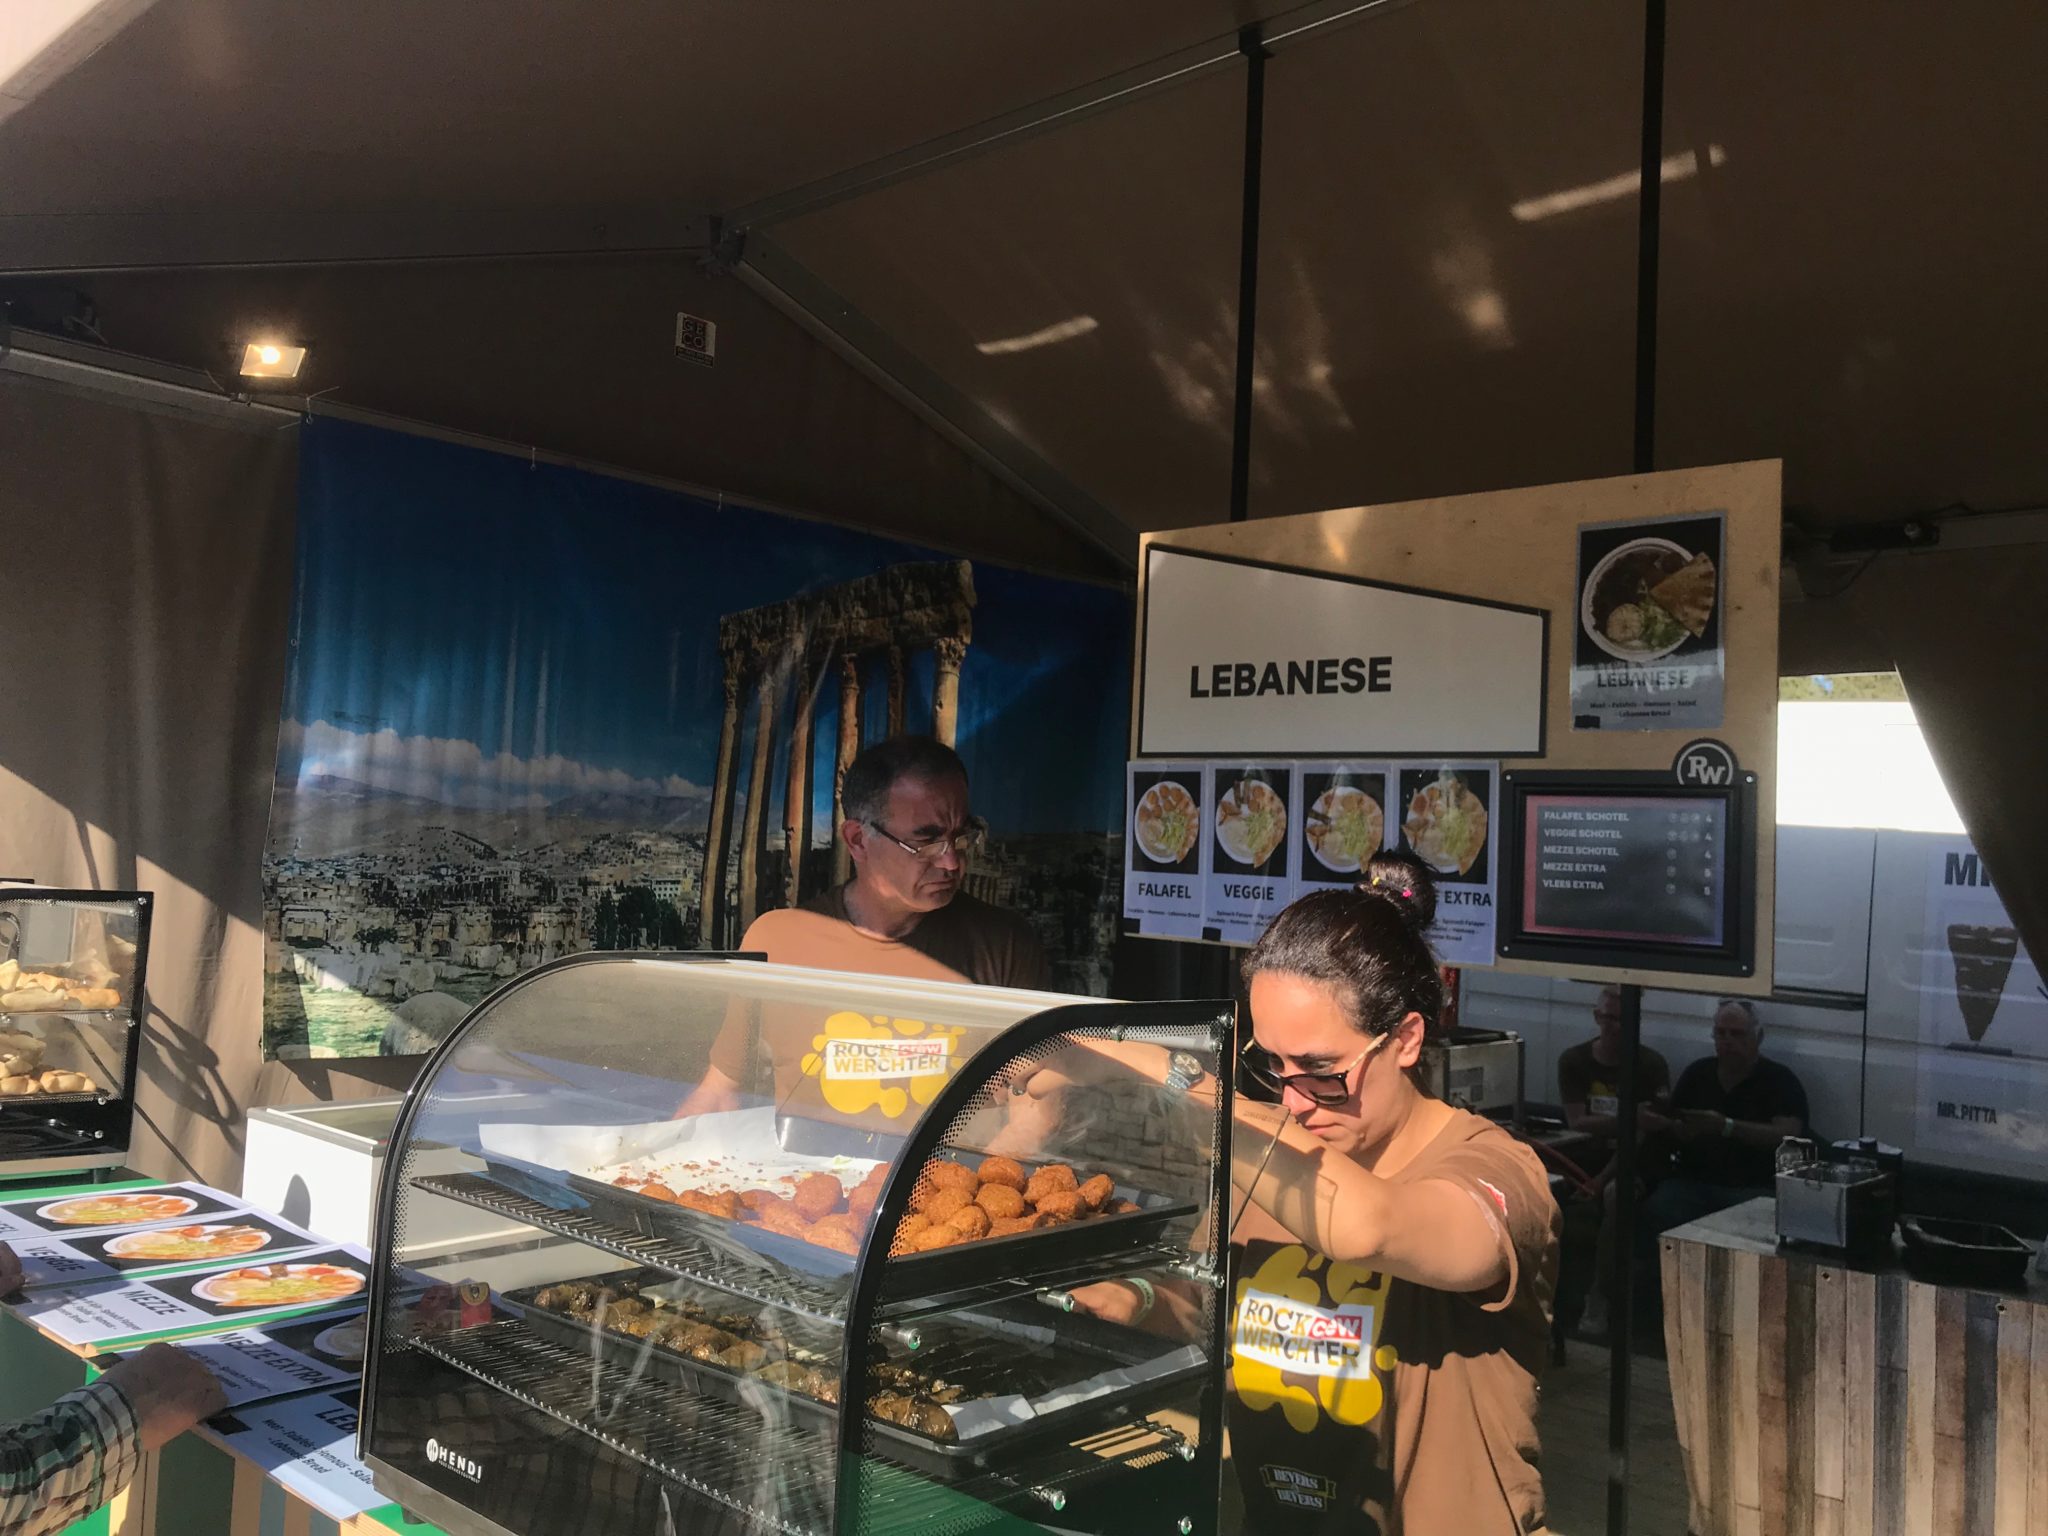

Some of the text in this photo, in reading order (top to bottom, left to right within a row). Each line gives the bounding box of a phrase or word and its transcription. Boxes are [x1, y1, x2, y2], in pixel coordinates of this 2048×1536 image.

[1190, 656, 1393, 698] LEBANESE
[1597, 668, 1690, 688] LEBANESE
[1687, 756, 1726, 785] RW
[1544, 811, 1584, 821] FALAFEL
[1586, 812, 1630, 822] SCHOTEL
[1544, 829, 1578, 838] VEGGIE
[1579, 830, 1623, 839] SCHOTEL
[1543, 845, 1575, 855] MEZZE
[1576, 846, 1620, 856] SCHOTEL
[1543, 862, 1574, 871] MEZZE
[1575, 863, 1607, 873] EXTRA
[1138, 883, 1191, 899] FALAFEL
[1224, 884, 1274, 900] VEGGIE
[1542, 879, 1572, 889] VLEES
[1573, 880, 1604, 890] EXTRA
[1444, 890, 1492, 907] EXTRA
[834, 1044, 894, 1058] ROCK
[834, 1054, 941, 1073] WERCHTER
[24, 1246, 86, 1273] VEGGIE
[117, 1290, 187, 1316] MEZZE
[1244, 1298, 1312, 1337] ROCK
[1243, 1322, 1360, 1368] WERCHTER
[213, 1332, 276, 1361] MEZZE
[264, 1357, 335, 1385] EXTRA
[302, 1457, 332, 1474] Bread
[439, 1446, 482, 1480] HENDI
